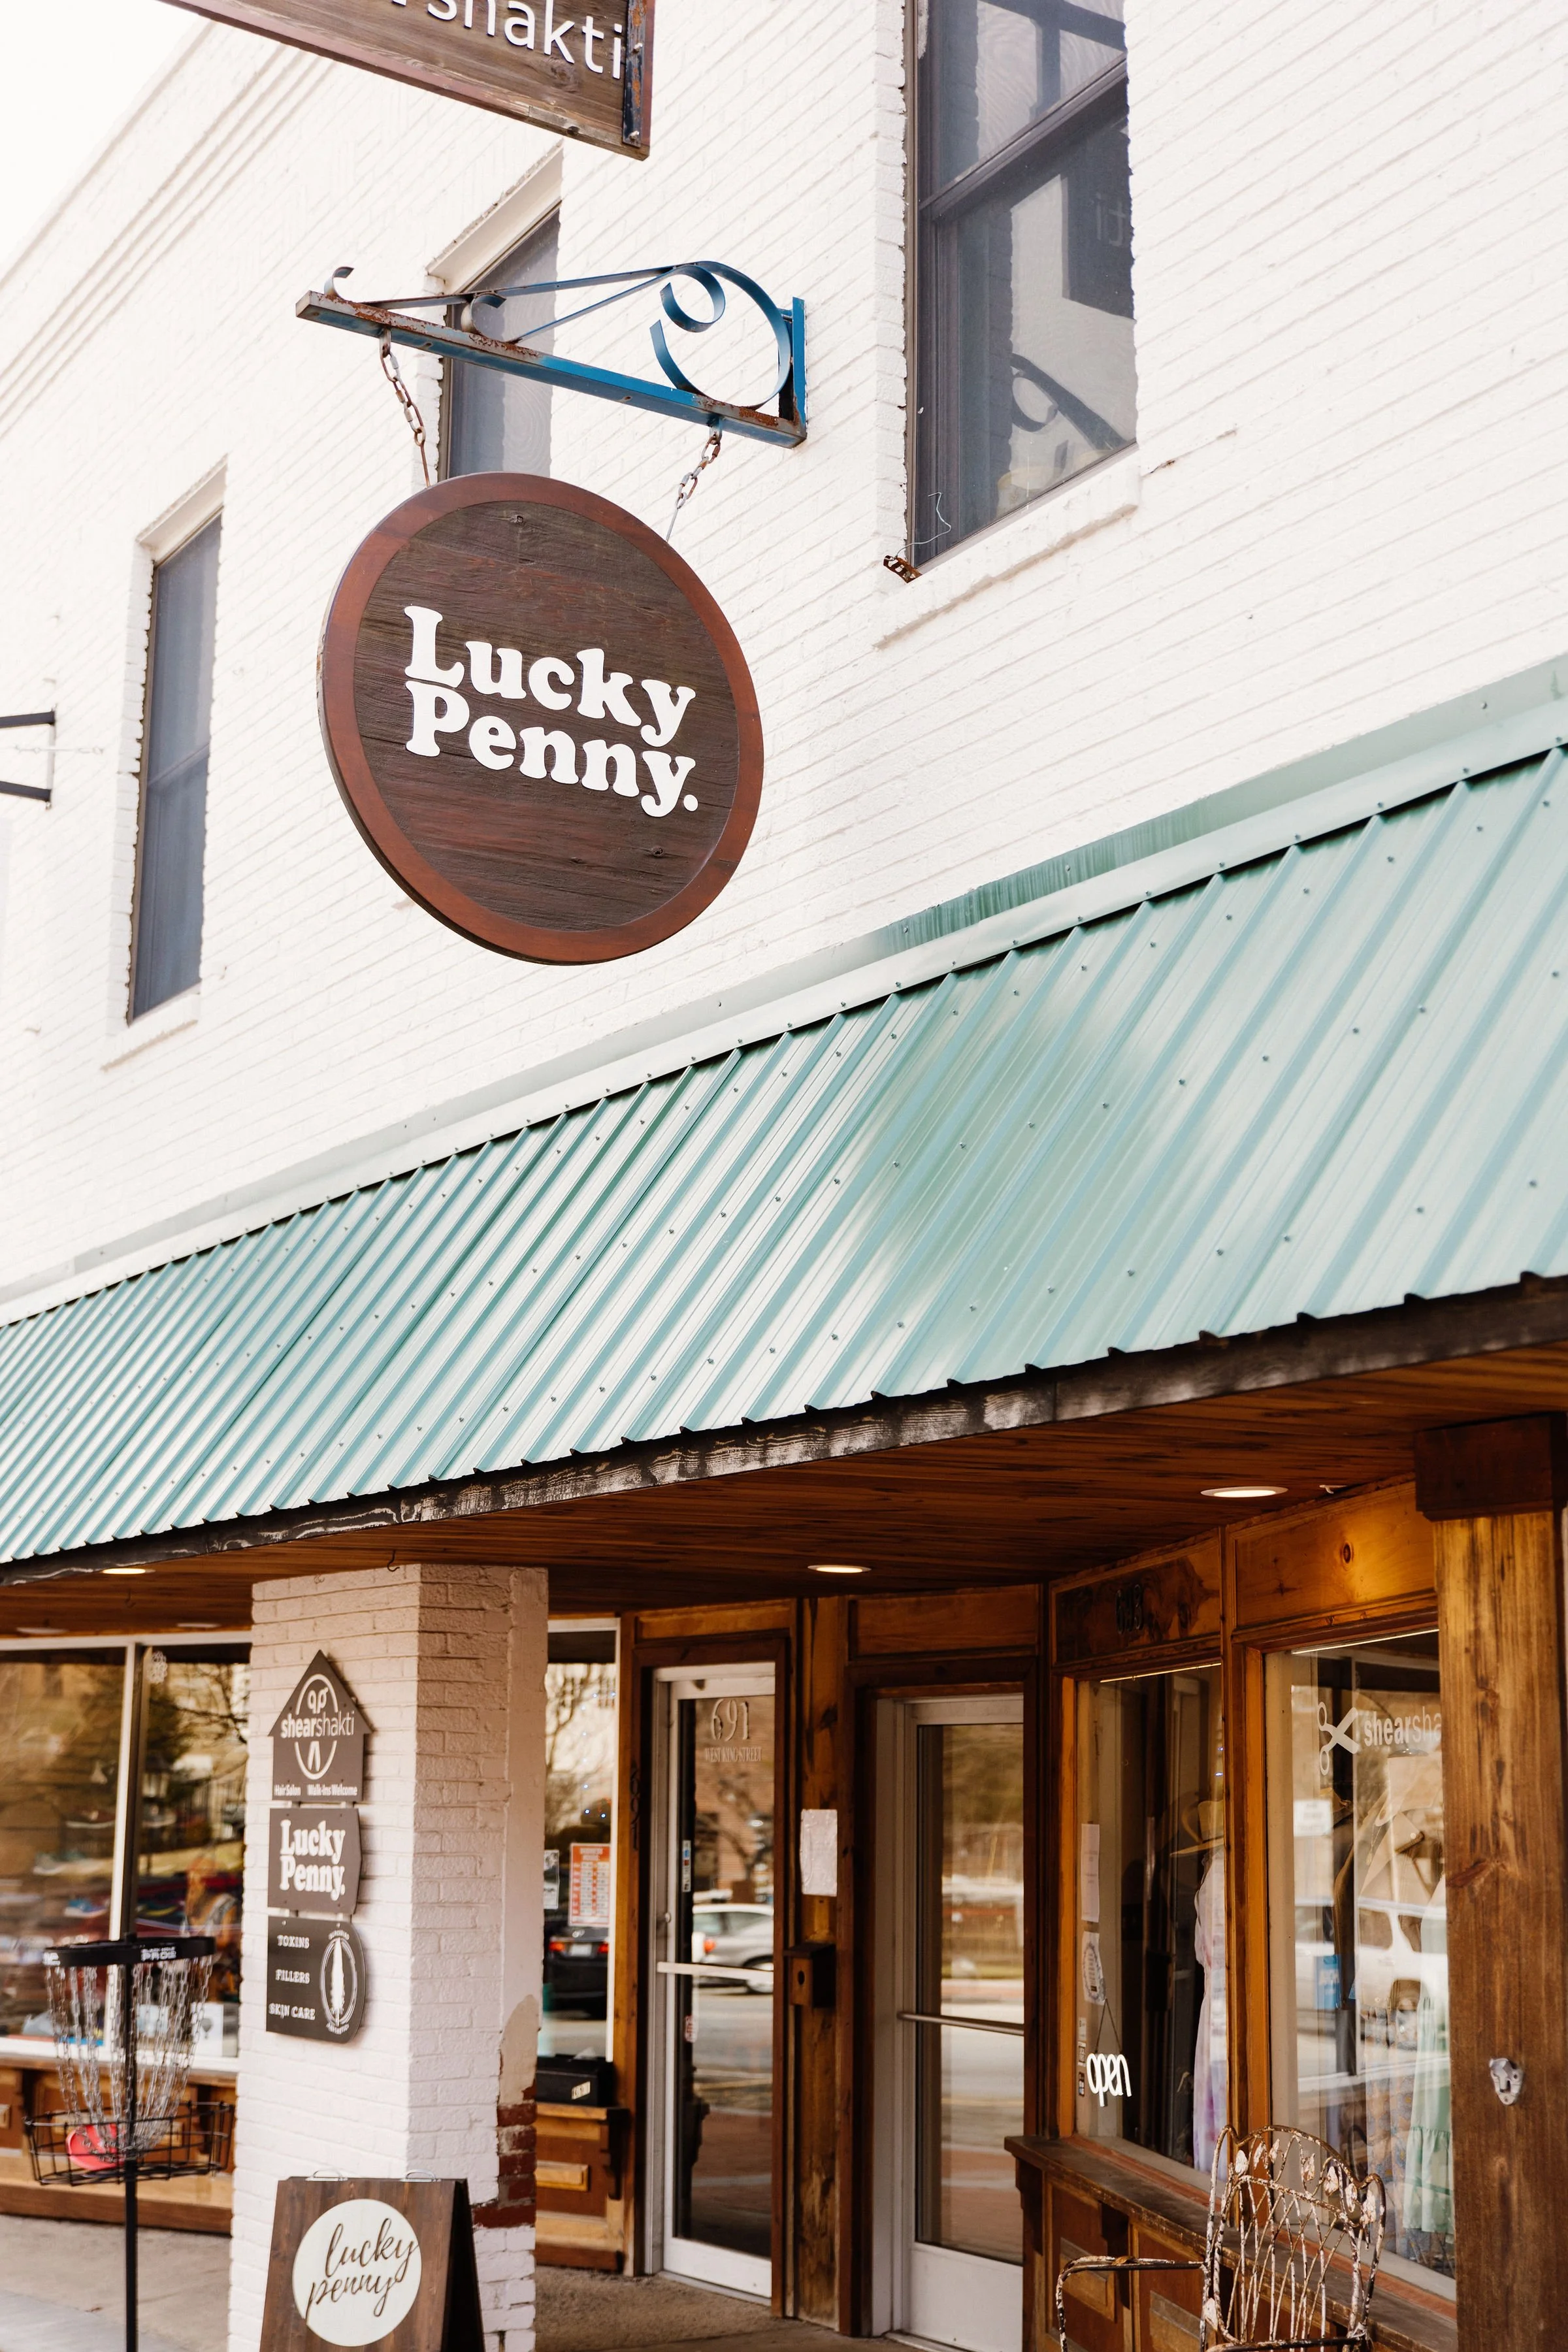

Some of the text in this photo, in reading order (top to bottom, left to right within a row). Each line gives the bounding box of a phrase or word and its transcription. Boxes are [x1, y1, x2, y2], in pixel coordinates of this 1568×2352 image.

[391, 0, 622, 79] hakti
[404, 606, 696, 747] Lucky
[405, 680, 698, 817] Penny.
[280, 1710, 355, 1739] shearshakti
[711, 1699, 749, 1742] 691
[705, 1747, 721, 1762] WEST
[738, 1746, 762, 1762] STREET
[286, 1784, 301, 1796] Salon
[331, 1783, 357, 1796] Welcome
[280, 1819, 346, 1865] Lucky
[279, 1855, 346, 1901] Penny.
[277, 1935, 310, 1949] TOXINS
[275, 1969, 310, 1984] FILLERS
[269, 2002, 316, 2020] SKIN CARE
[1086, 2053, 1132, 2107] open
[325, 2218, 419, 2283] lucky
[304, 2274, 400, 2319] penny
